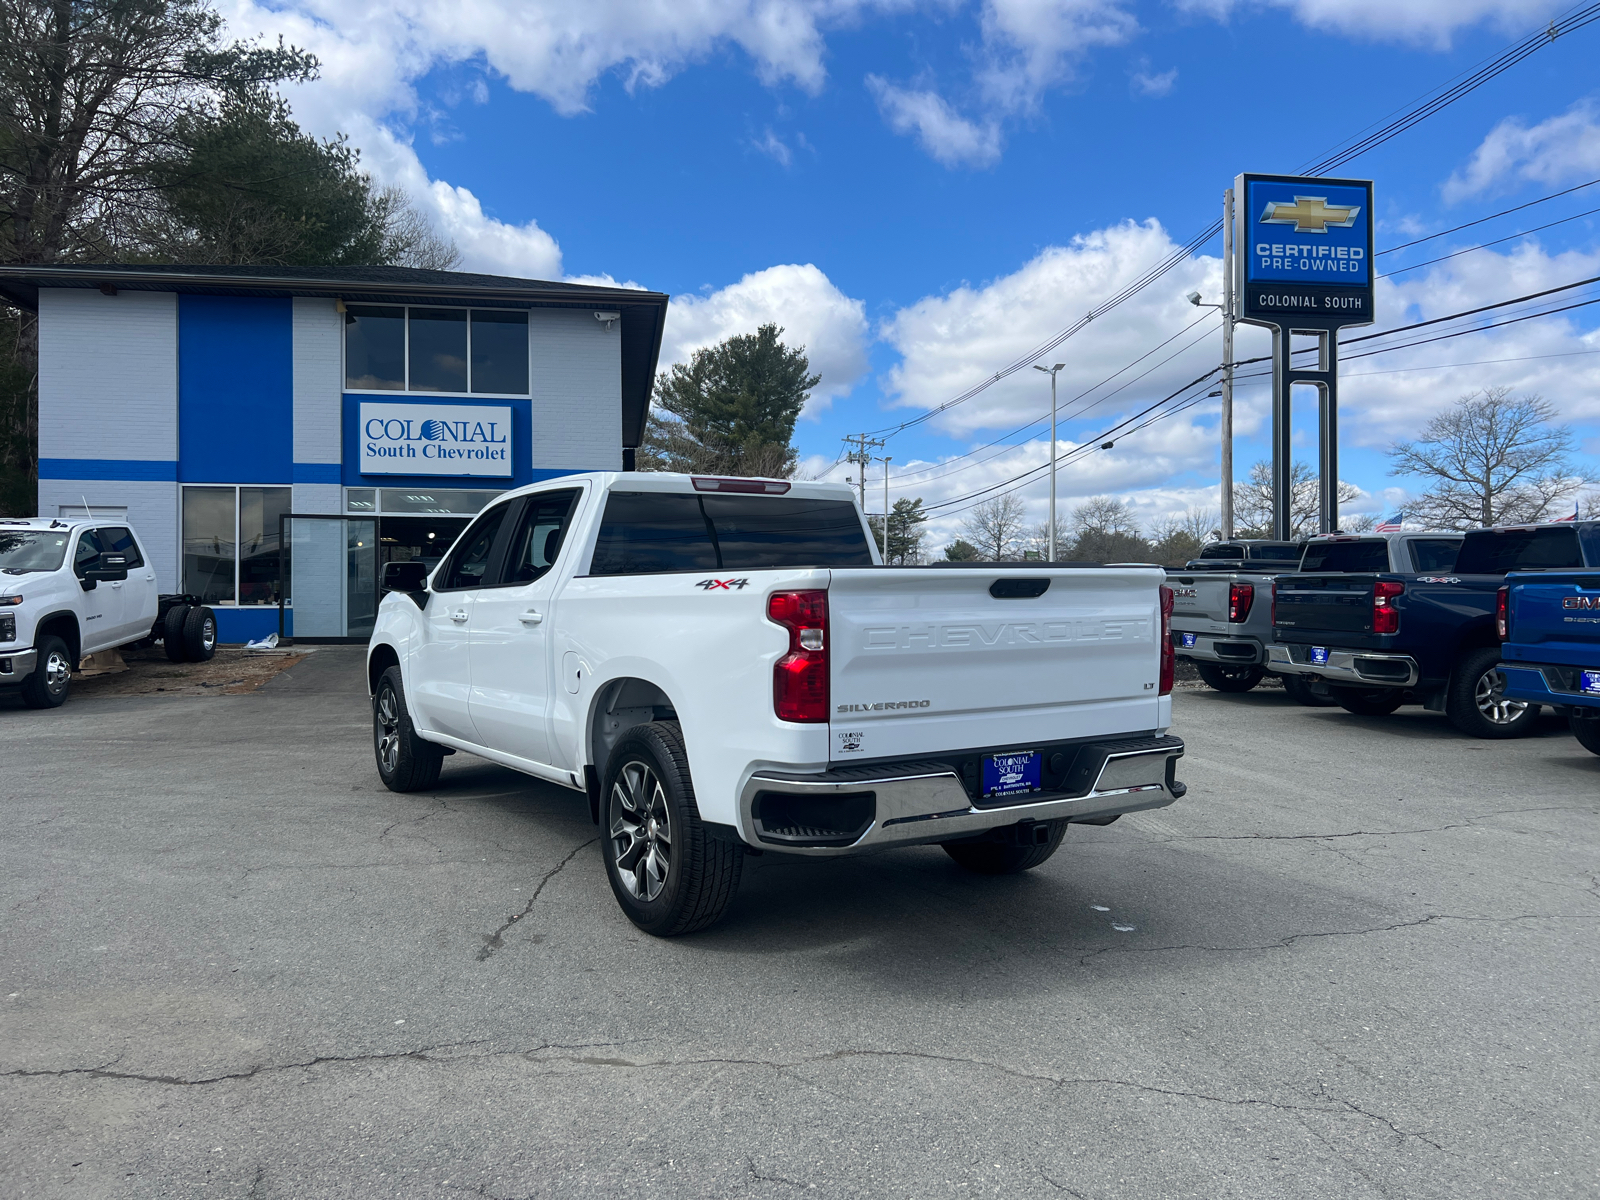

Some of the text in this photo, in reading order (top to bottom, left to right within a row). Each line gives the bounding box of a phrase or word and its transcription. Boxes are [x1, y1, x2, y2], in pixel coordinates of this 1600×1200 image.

[1256, 243, 1364, 260] CERTIFIED
[1261, 257, 1359, 272] PRE-OWNED
[1259, 294, 1362, 309] COLONIAL SOUTH
[365, 418, 507, 443] COLONIAL
[366, 442, 506, 460] South Chevrolet
[1174, 589, 1197, 598] GMC
[862, 618, 1148, 650] CHEVROLET
[1144, 682, 1155, 690] LT
[837, 700, 930, 713] SILVERADO
[993, 756, 1030, 768] COLONIAL
[998, 764, 1024, 775] SOUTH
